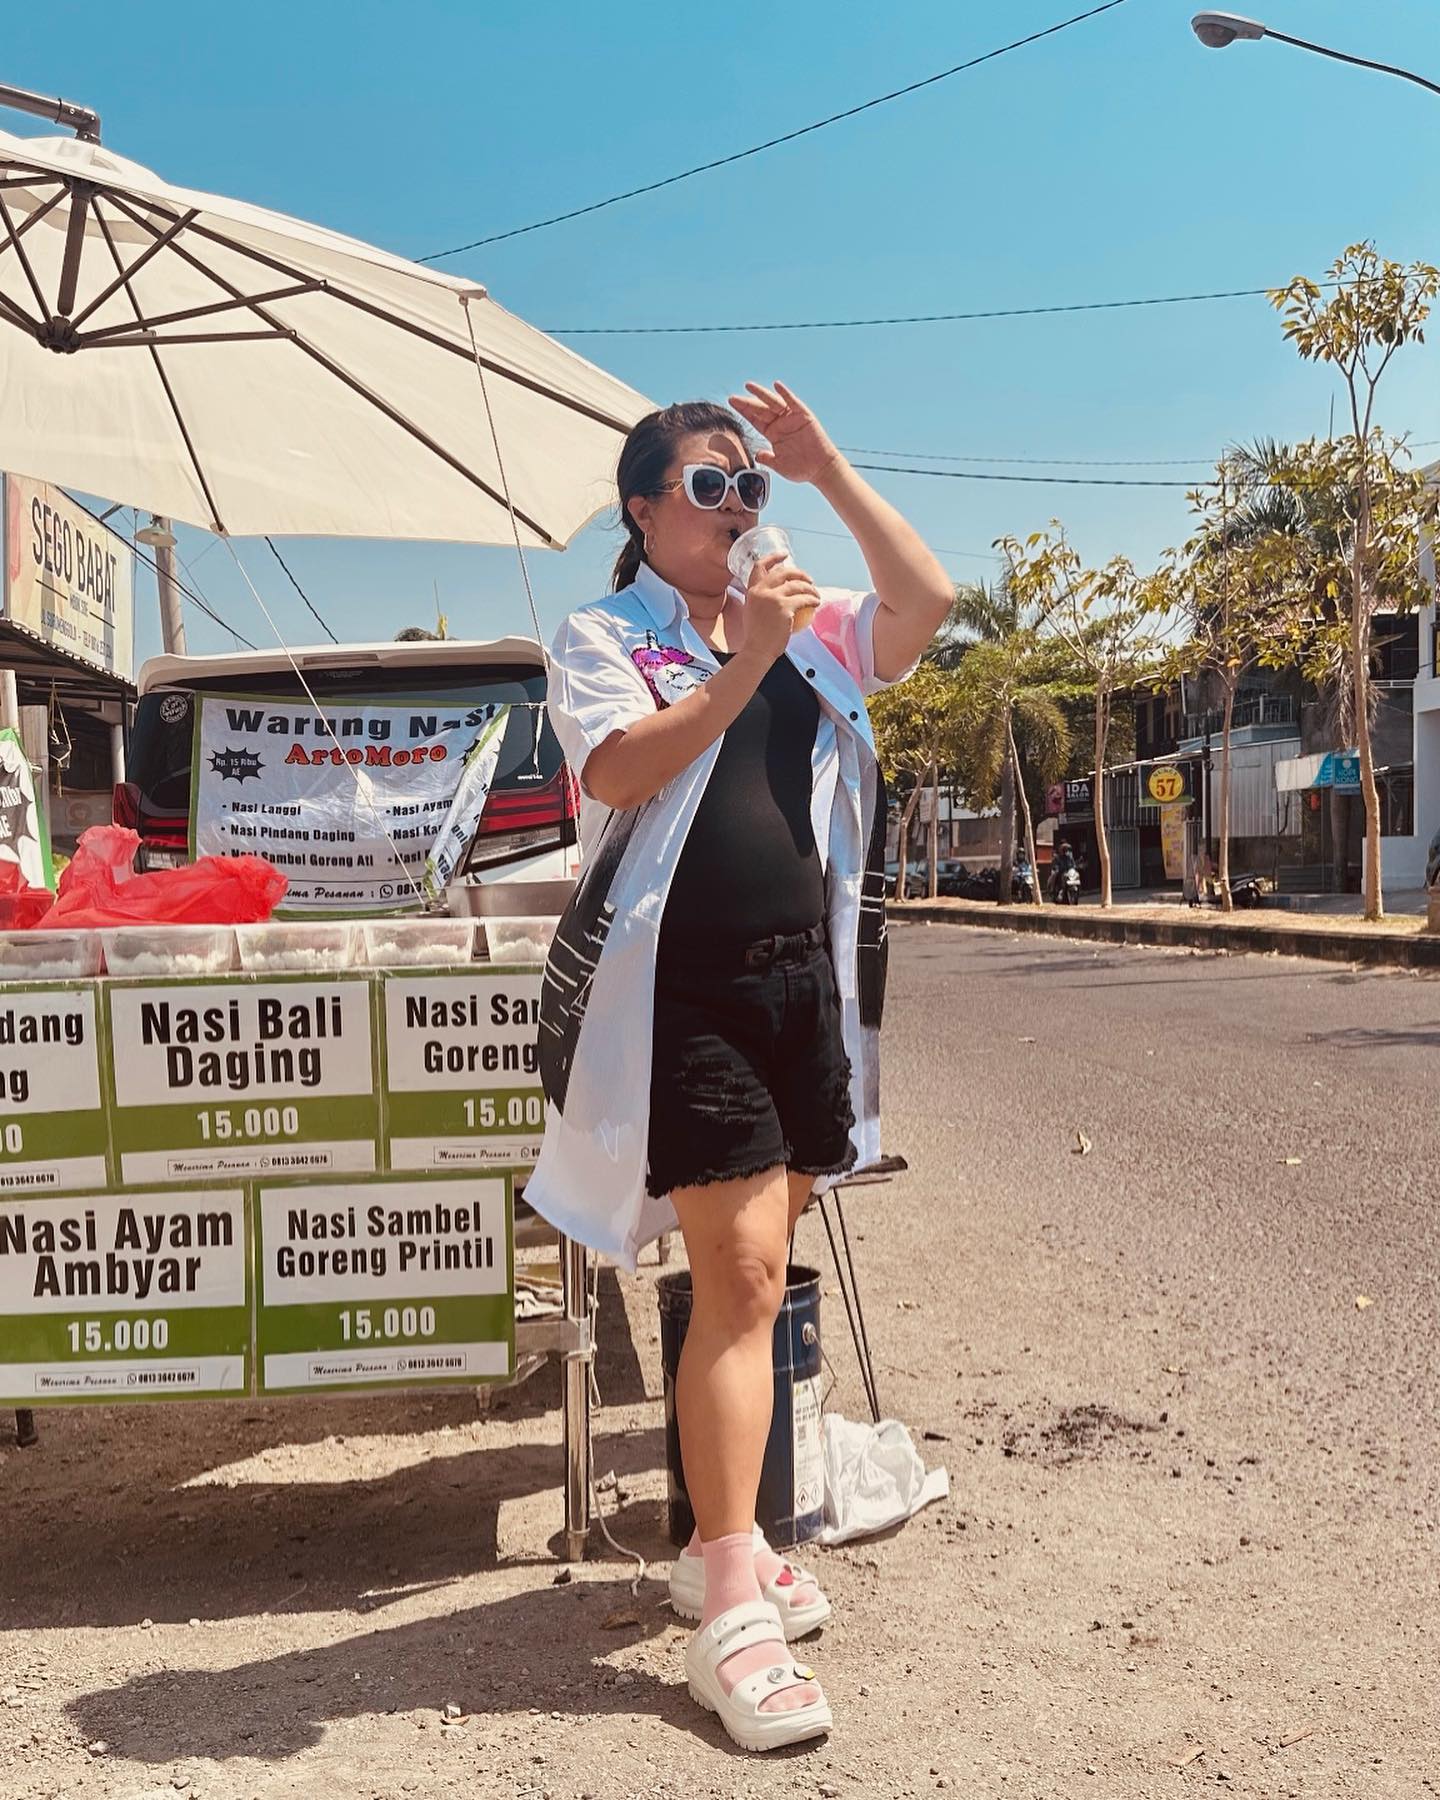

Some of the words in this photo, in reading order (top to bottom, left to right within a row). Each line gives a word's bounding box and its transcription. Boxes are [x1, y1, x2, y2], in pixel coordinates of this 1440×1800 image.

[32, 496, 72, 584] SEGO
[76, 529, 117, 614] BABAT
[225, 708, 391, 740] Warung
[231, 758, 239, 767] 15
[284, 743, 448, 767] ArtoMoro
[231, 768, 241, 776] AE
[1067, 783, 1089, 793] IDA
[1156, 778, 1176, 797] 57
[232, 802, 257, 813] Nasi
[261, 803, 302, 816] Langgi
[392, 804, 419, 816] Nasi
[422, 799, 453, 812] Ayam
[230, 824, 257, 837] Nasi
[260, 827, 310, 841] Pindang
[313, 829, 356, 842] Daging
[393, 826, 420, 840] Nasi
[261, 851, 306, 865] Sambel
[310, 854, 353, 868] Goreng
[356, 855, 374, 867] Ati
[314, 887, 364, 899] Pesanan
[141, 999, 240, 1045] Nasi
[258, 996, 342, 1040] Bali
[406, 994, 478, 1028] Nasi
[167, 1042, 322, 1090] Daging
[424, 1041, 538, 1074] Goreng
[197, 1106, 299, 1140] 15.000
[463, 1096, 545, 1127] 15.00
[0, 1210, 97, 1255] Nasi
[114, 1208, 233, 1255] Ayam
[288, 1207, 356, 1240] Nasi
[367, 1201, 481, 1237] Sambel
[277, 1246, 387, 1278] Goreng
[399, 1237, 494, 1272] Printil
[33, 1252, 202, 1300] Ambyar
[67, 1319, 169, 1353] 15.000
[339, 1306, 436, 1341] 15.000
